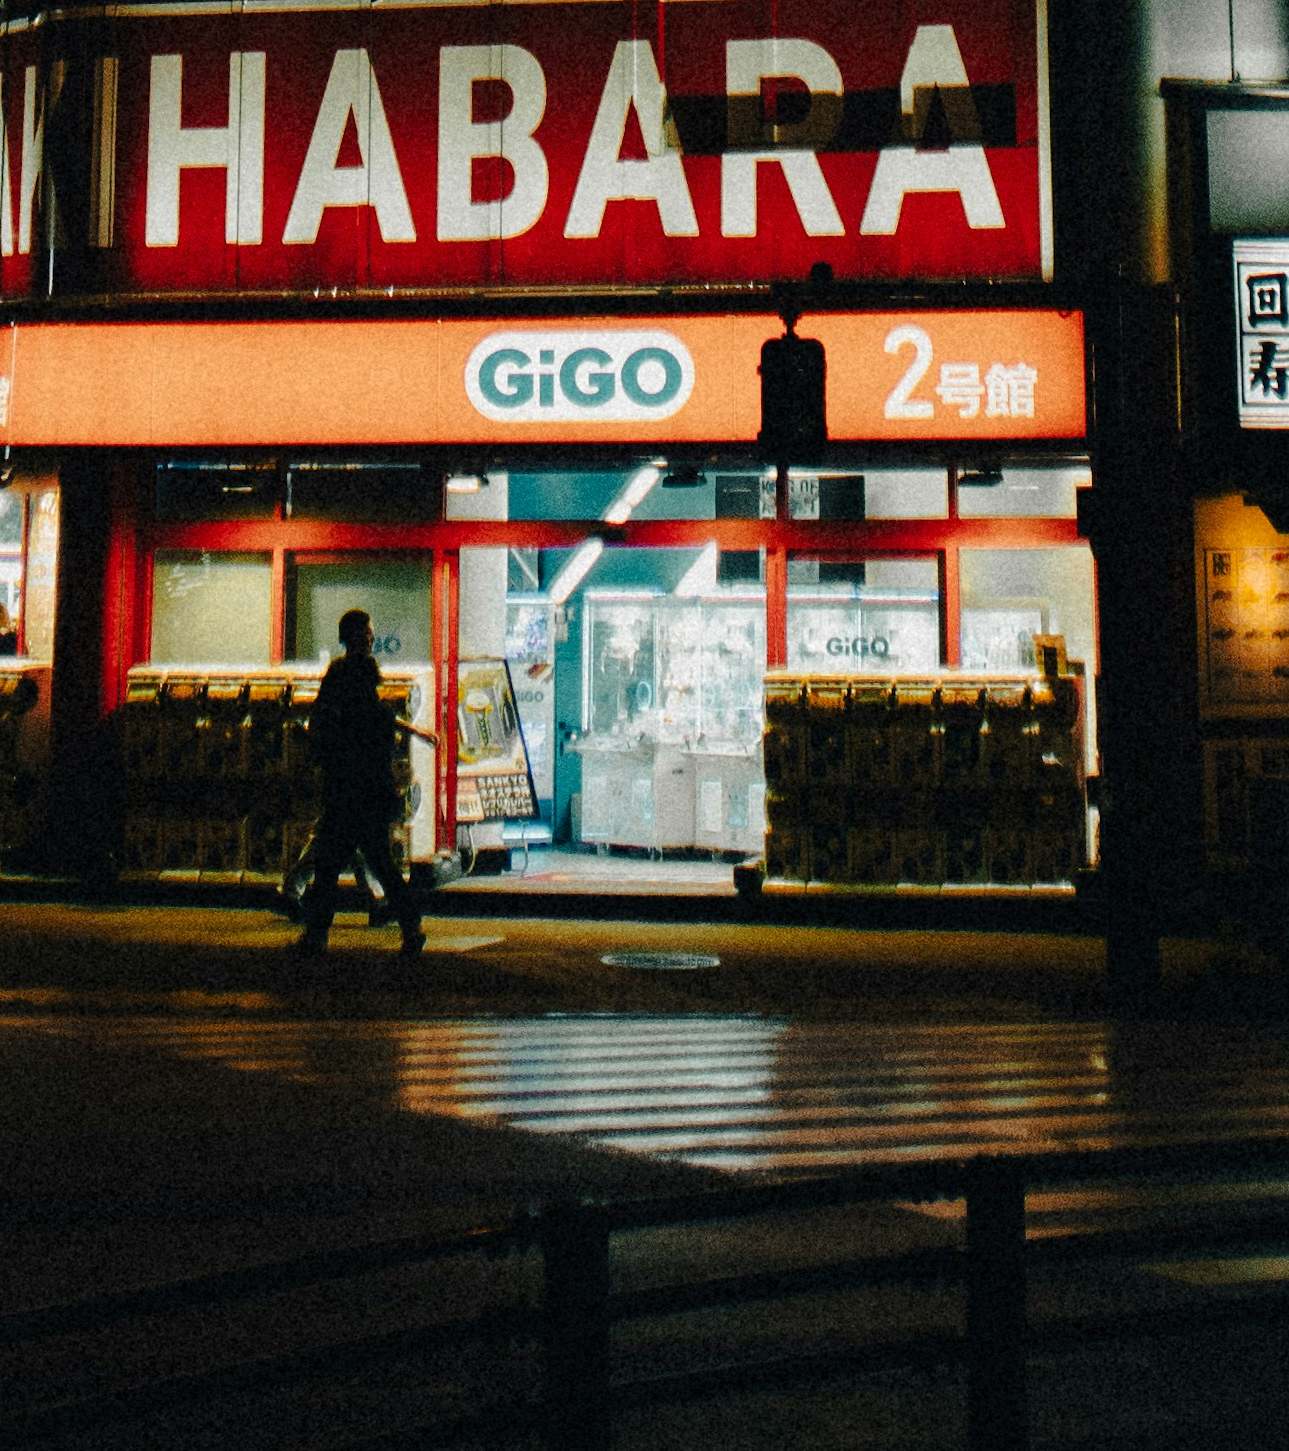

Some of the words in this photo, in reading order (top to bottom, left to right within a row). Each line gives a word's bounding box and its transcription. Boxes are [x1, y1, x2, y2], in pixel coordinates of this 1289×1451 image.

[478, 346, 683, 408] GiGO
[883, 324, 1039, 420] 2号館
[826, 636, 890, 658] GiGO
